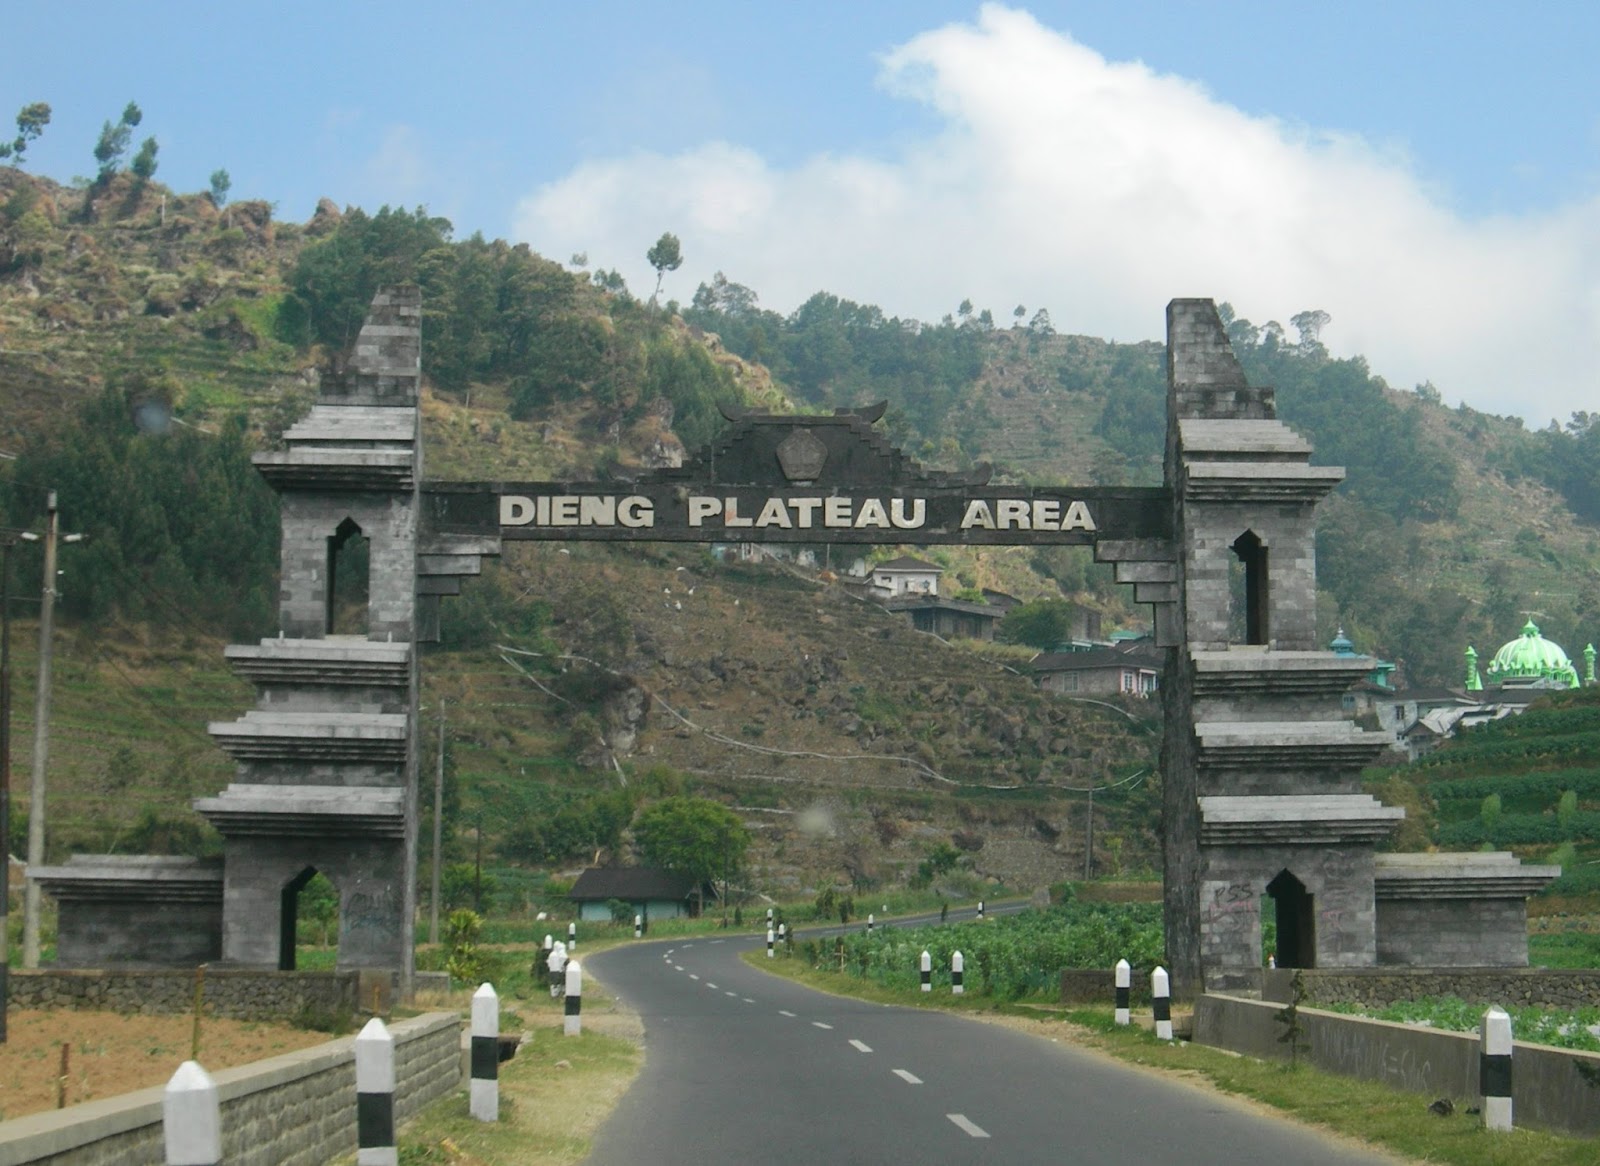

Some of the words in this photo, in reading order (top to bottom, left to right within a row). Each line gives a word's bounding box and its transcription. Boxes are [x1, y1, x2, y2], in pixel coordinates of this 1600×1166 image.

[500, 496, 654, 527] DIENG
[688, 496, 926, 529] PLATEAU
[960, 499, 1096, 531] AREA
